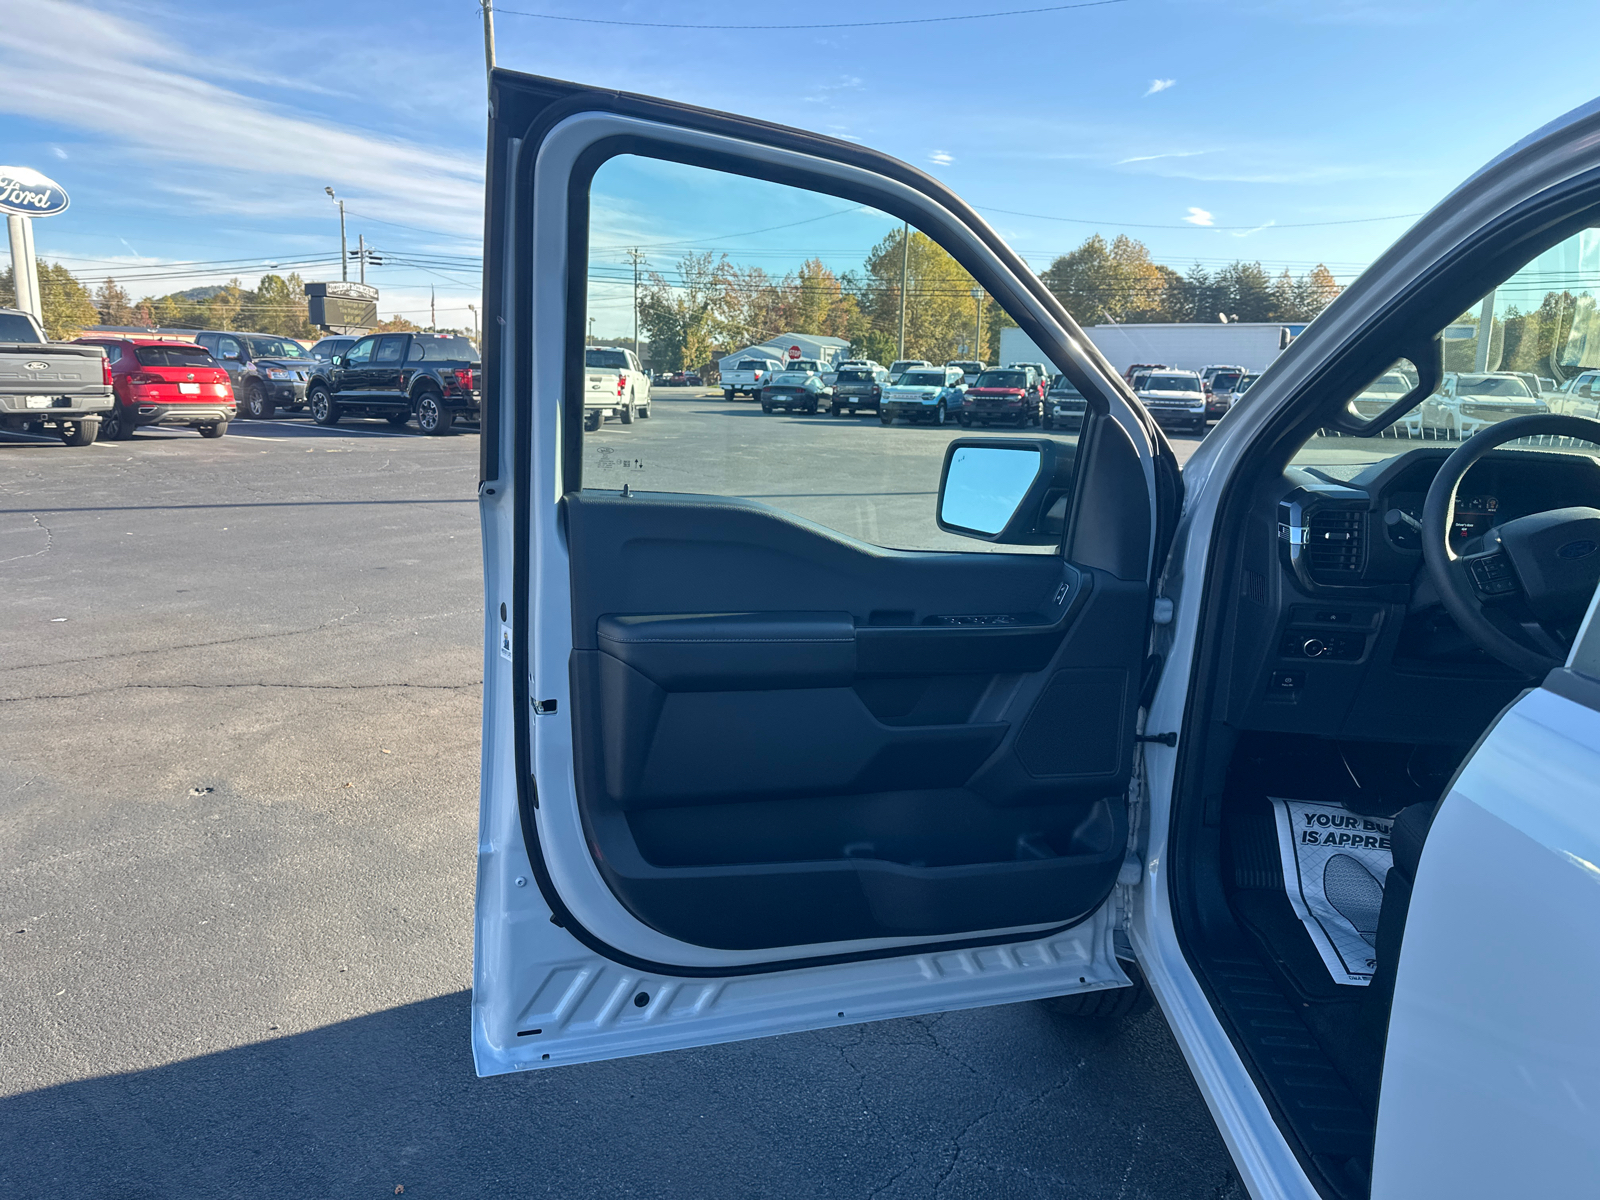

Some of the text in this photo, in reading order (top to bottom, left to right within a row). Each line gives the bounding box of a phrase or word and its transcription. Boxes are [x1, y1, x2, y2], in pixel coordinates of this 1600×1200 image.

[0, 178, 51, 208] Ford
[1304, 813, 1393, 834] YOUR BU
[1301, 830, 1391, 849] IS APPRE
